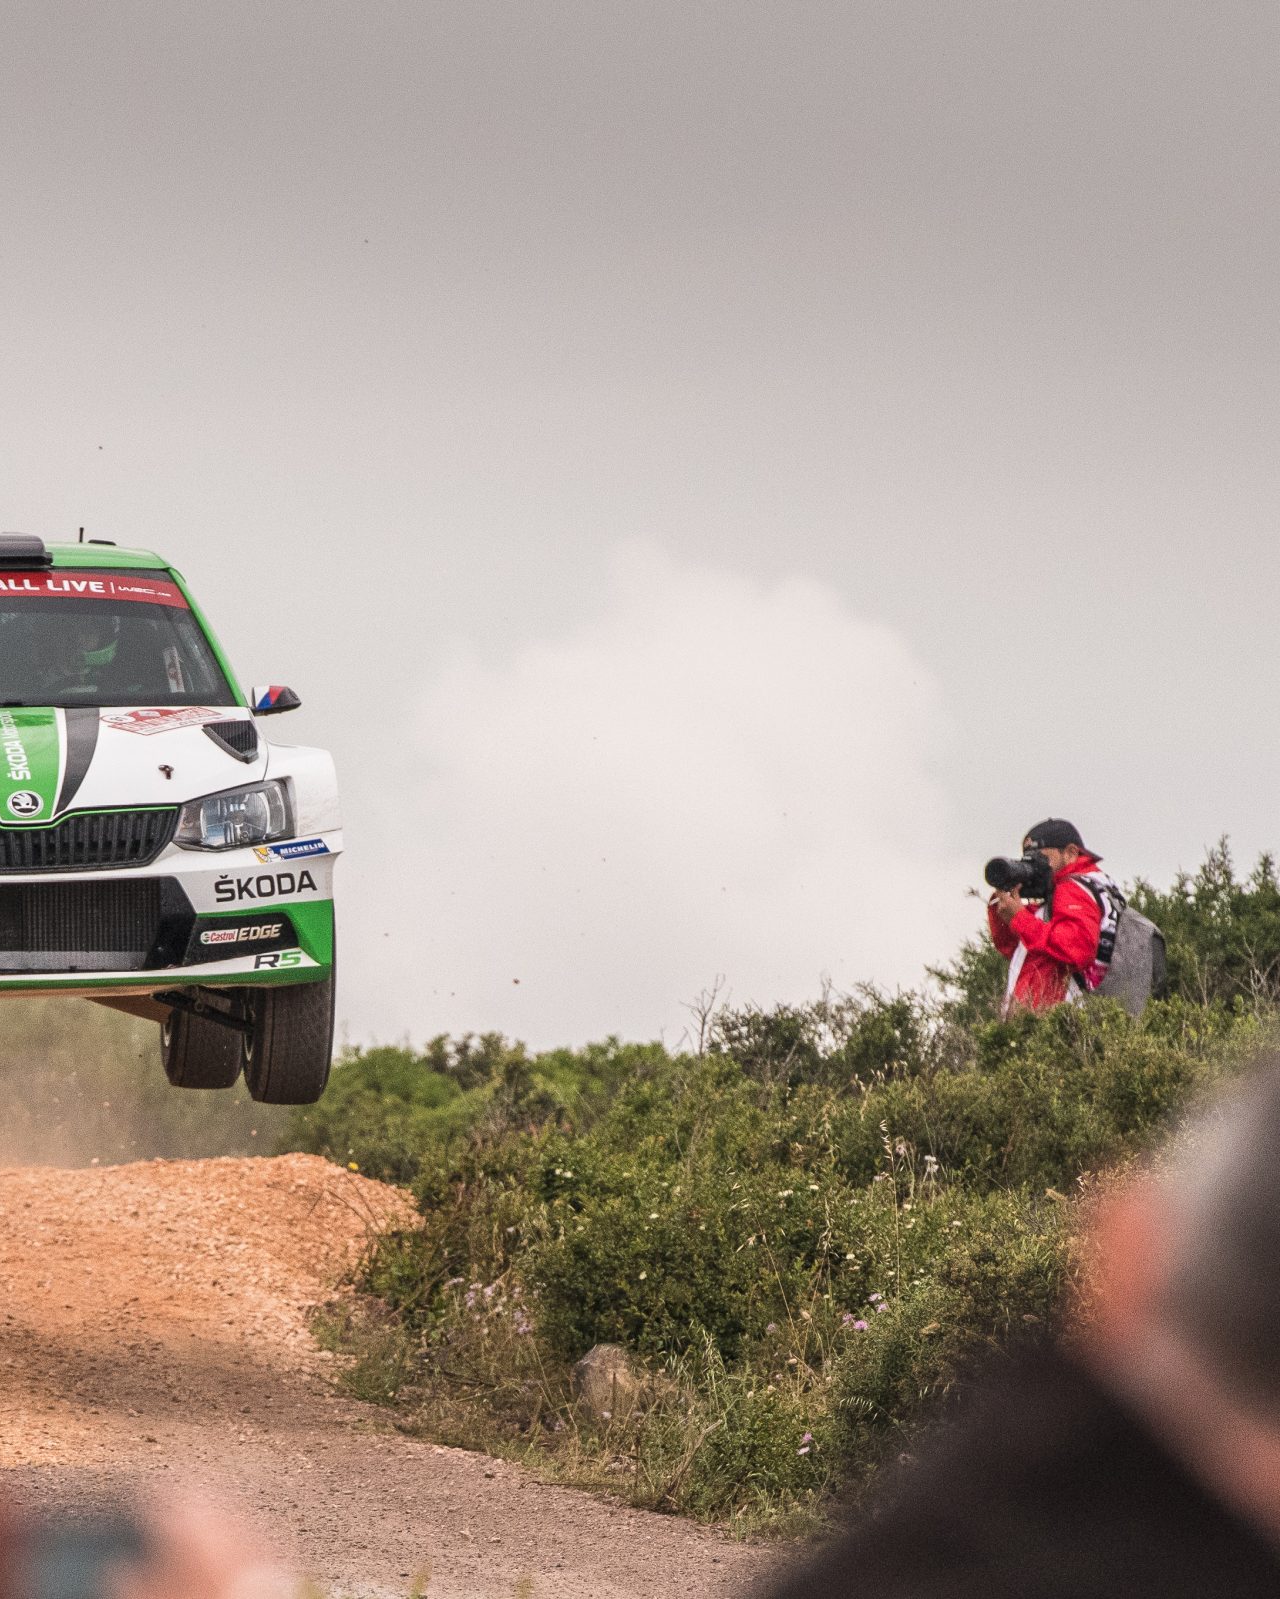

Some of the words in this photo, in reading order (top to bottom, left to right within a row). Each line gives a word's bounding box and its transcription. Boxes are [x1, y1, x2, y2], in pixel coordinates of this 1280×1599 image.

[46, 579, 105, 593] LIVE
[4, 739, 31, 781] ŠKODA
[280, 842, 324, 853] MICHELIN
[215, 870, 317, 903] ŠKODA
[210, 931, 236, 942] Castrol
[237, 923, 283, 942] EDGE
[254, 951, 302, 969] R5
